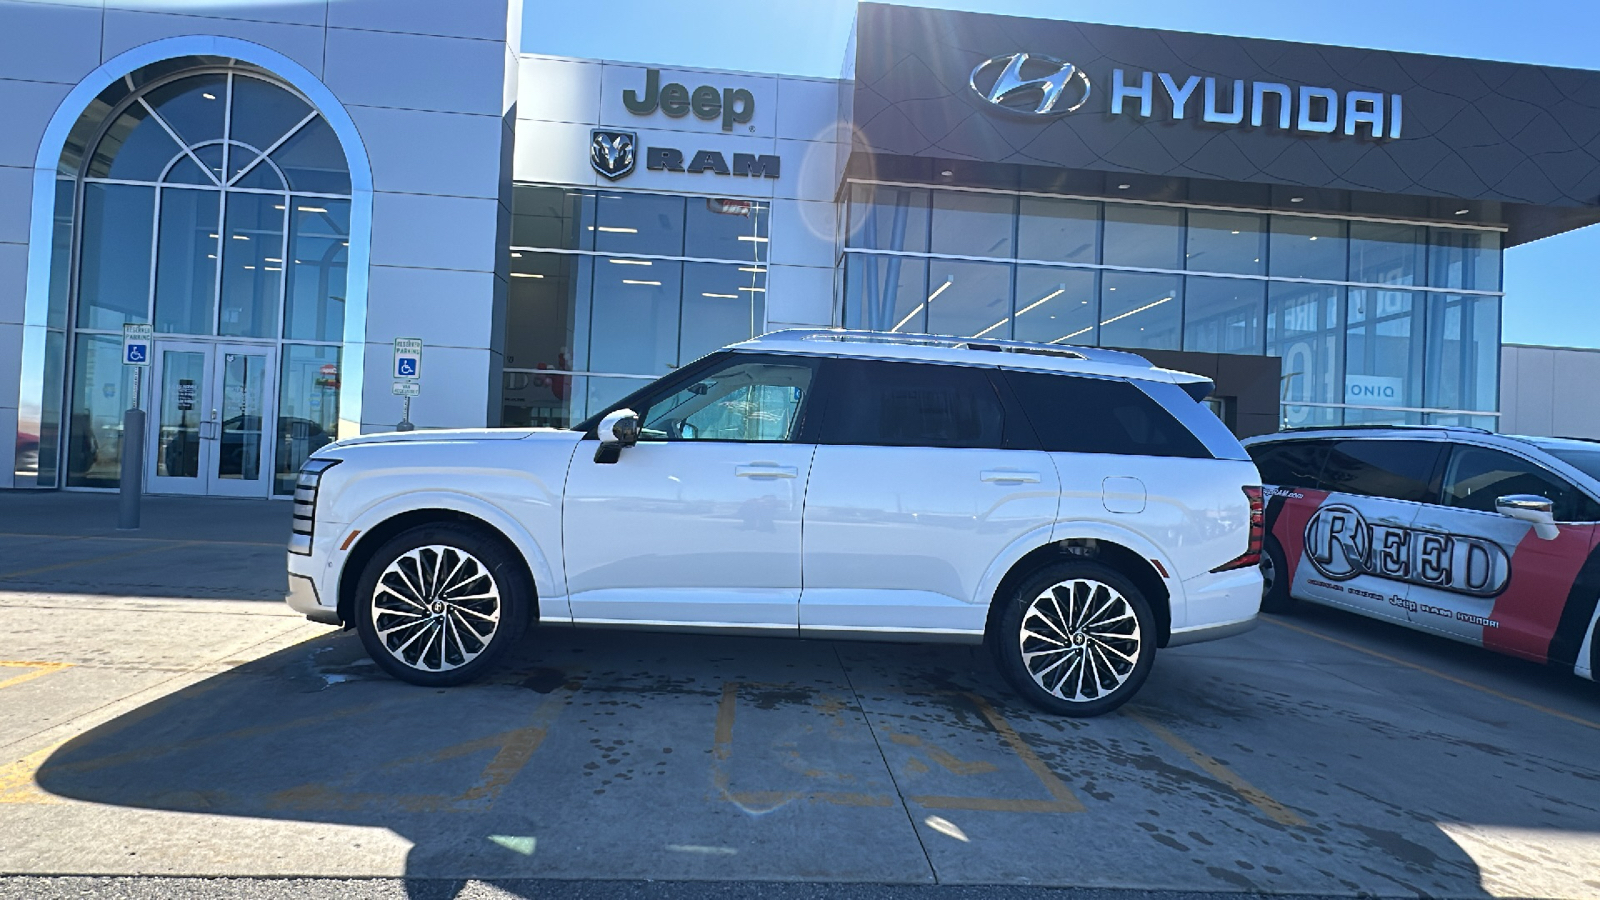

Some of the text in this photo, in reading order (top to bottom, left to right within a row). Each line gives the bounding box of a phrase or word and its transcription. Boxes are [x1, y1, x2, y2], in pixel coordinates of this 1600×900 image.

[622, 68, 755, 131] Jeep
[1111, 68, 1402, 139] HYUNDAI
[647, 146, 781, 178] RAM
[1306, 505, 1510, 596] REED
[1389, 594, 1417, 613] Jeep
[1420, 603, 1453, 618] RAM
[1456, 611, 1500, 628] HYUNDAI
